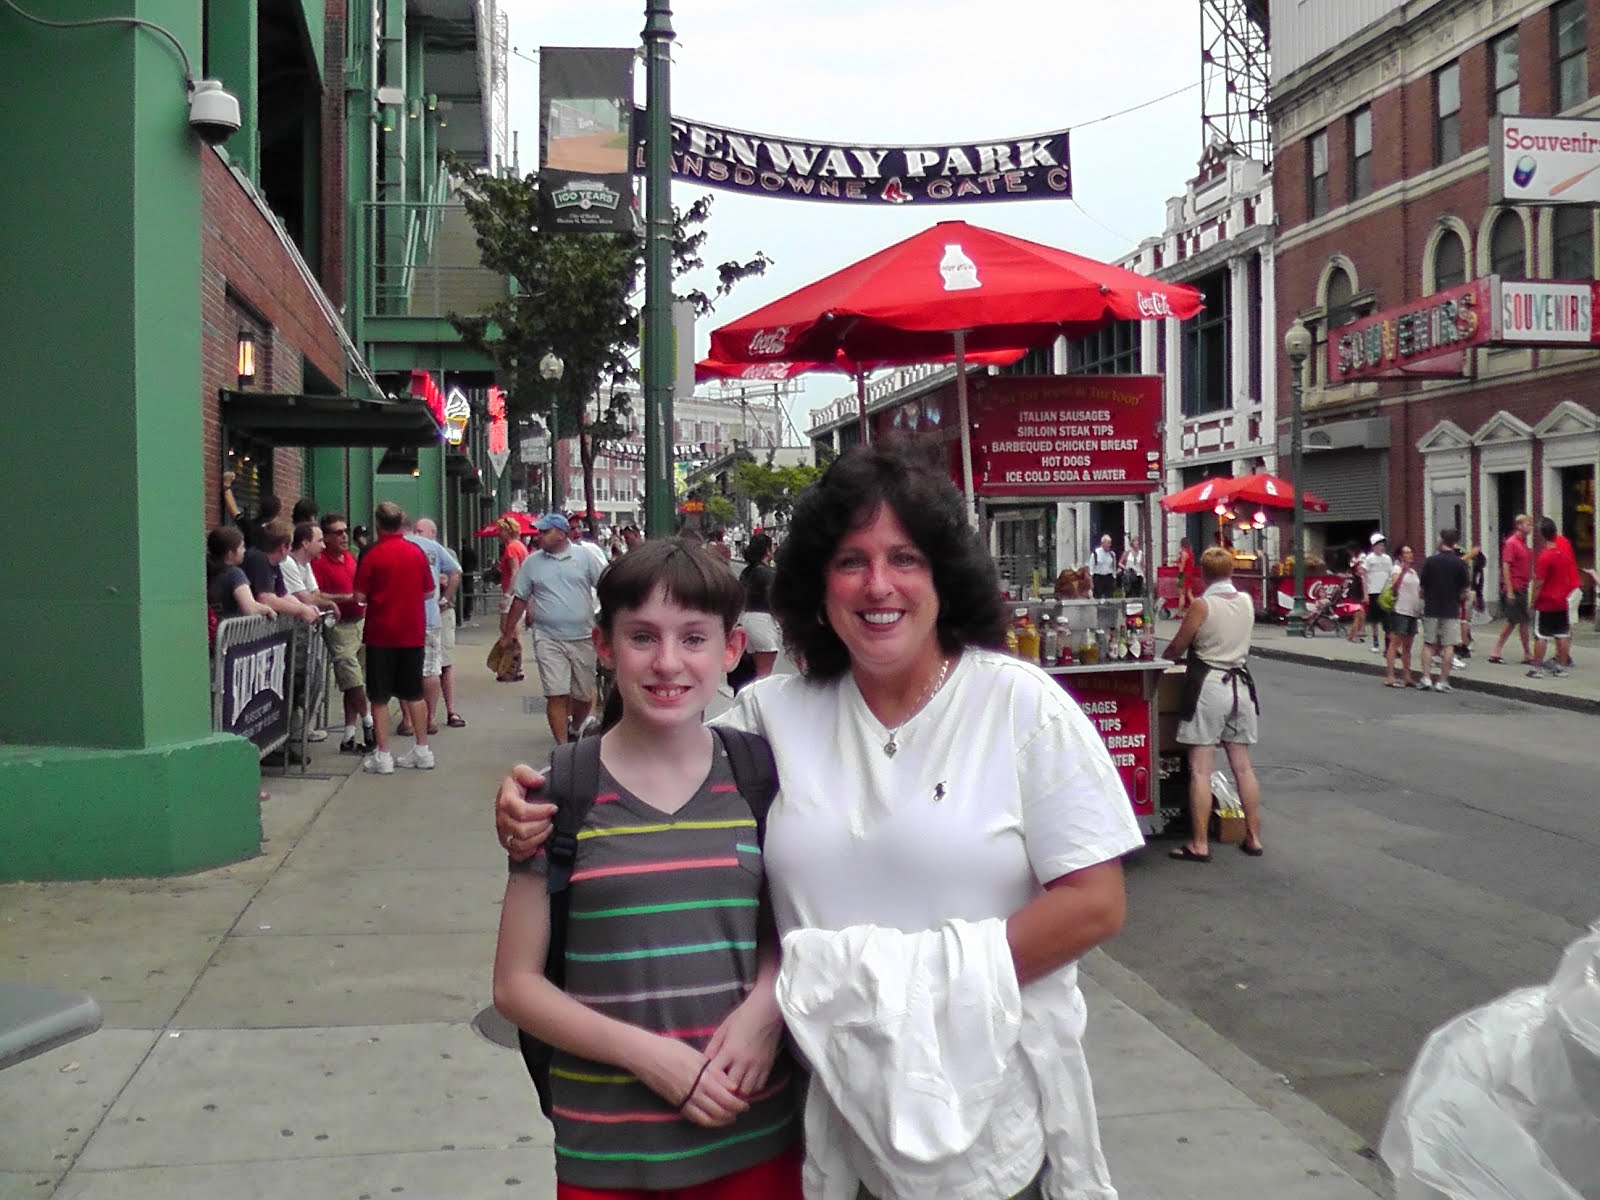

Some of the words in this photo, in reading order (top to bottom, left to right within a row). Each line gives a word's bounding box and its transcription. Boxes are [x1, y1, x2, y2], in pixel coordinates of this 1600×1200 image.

[1505, 127, 1600, 153] Souvenir
[903, 139, 1058, 178] PARK
[927, 170, 1028, 199] GATE
[559, 191, 578, 203] 100
[579, 191, 613, 203] YEARS
[1503, 292, 1591, 332] SOUVENIRS
[1337, 292, 1478, 374] SOUVENIRS
[1019, 411, 1058, 422] ITALIAN
[1059, 410, 1111, 422] SAUSAGES
[1017, 426, 1057, 437] SIRLOIN
[1059, 425, 1091, 437] STEAK
[1092, 425, 1114, 436] TIPS
[991, 440, 1053, 453] BARBEQUED
[1055, 440, 1099, 452] CHICKEN
[1100, 439, 1139, 451] BREAST
[1041, 456, 1062, 467] HOT
[1063, 455, 1092, 467] DOGS
[1005, 471, 1023, 482] ICE
[1024, 471, 1051, 482] COLD
[1053, 470, 1080, 481] SODA
[1082, 469, 1091, 480] &
[1092, 469, 1126, 480] WATER
[1099, 718, 1122, 731] TIPS
[1108, 734, 1146, 749] BREAST
